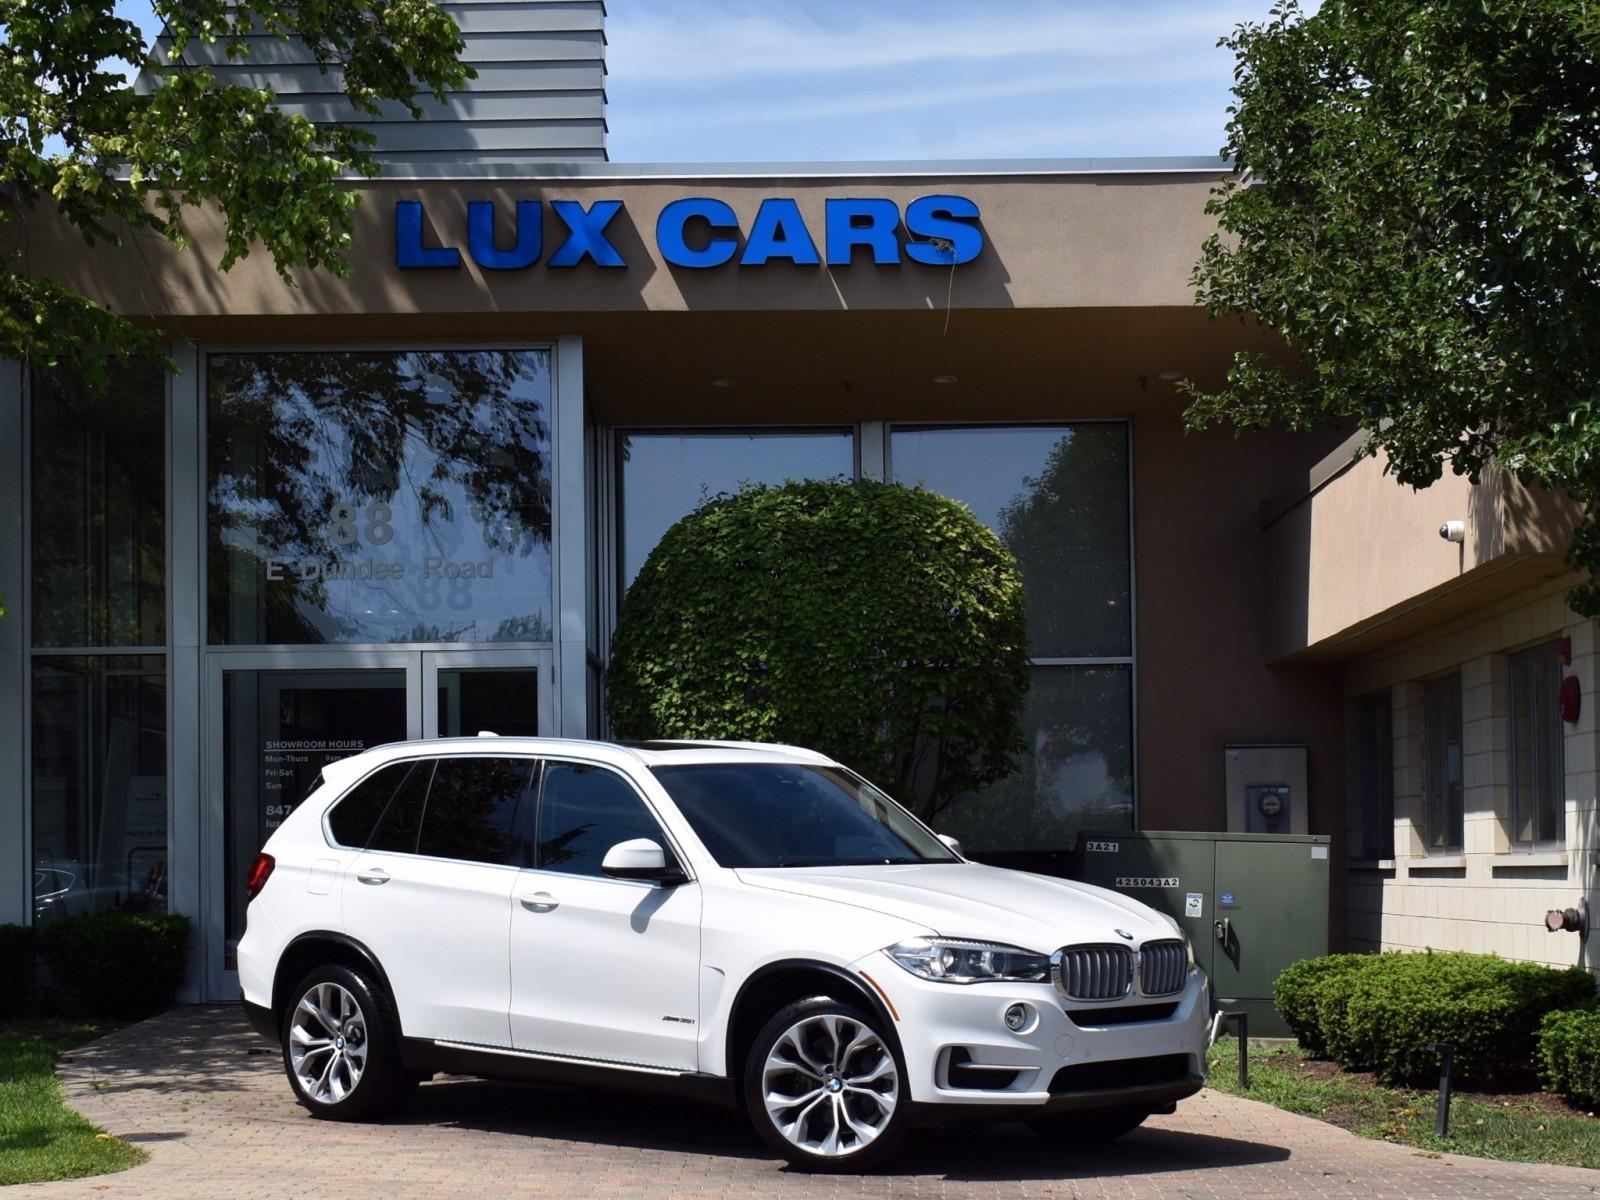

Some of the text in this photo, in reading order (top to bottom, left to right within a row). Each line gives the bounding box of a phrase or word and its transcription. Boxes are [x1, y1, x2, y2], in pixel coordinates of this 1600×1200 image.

[395, 194, 983, 270] LUX CARS
[330, 503, 394, 545] 88
[266, 556, 494, 581] E Dundee Road
[265, 740, 364, 750] SHOWROOM HOURS
[265, 755, 309, 763] Mon-Thurs
[265, 768, 294, 777] Fri-Sat
[265, 782, 283, 790] Sun
[1087, 842, 1118, 852] 3A21
[1116, 877, 1179, 887] 425043A2
